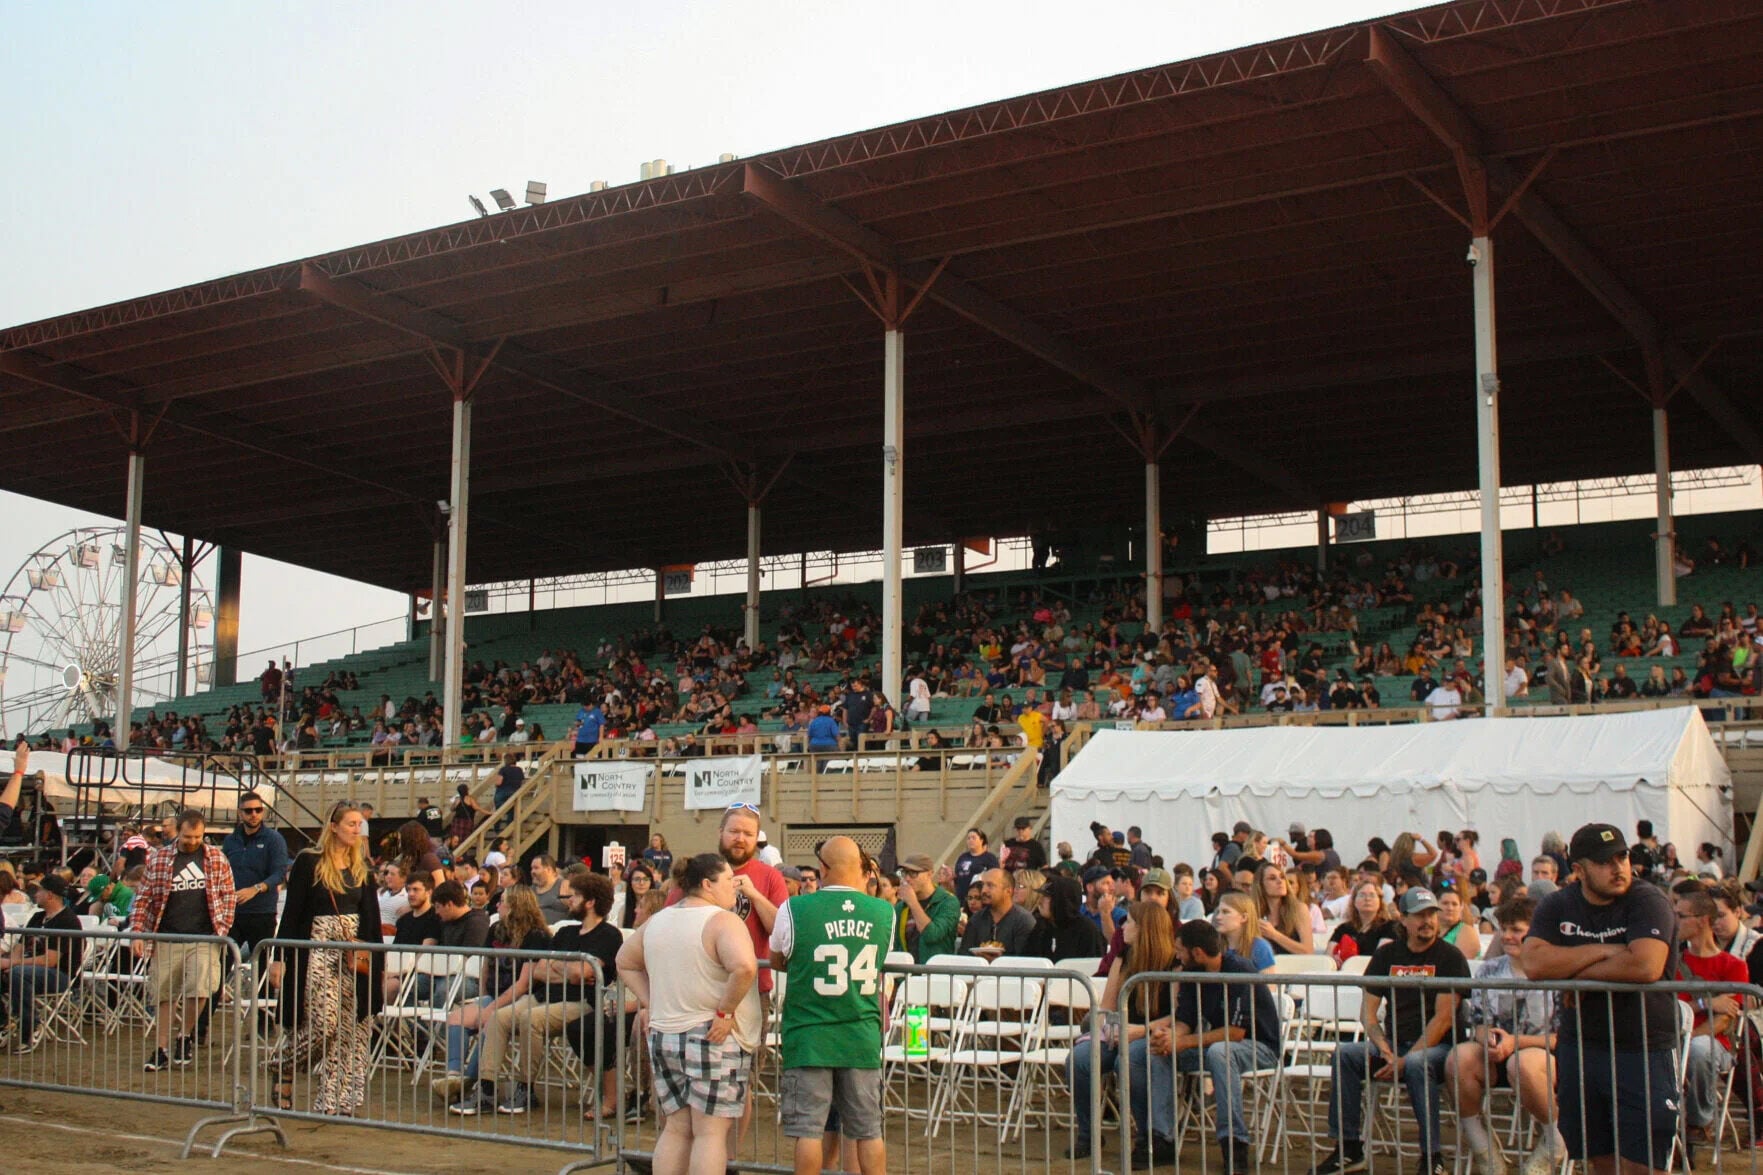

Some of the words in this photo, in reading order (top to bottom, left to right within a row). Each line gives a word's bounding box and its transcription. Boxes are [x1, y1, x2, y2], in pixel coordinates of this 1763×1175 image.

[1338, 516, 1372, 537] 204
[916, 551, 944, 569] 203
[666, 573, 689, 591] 202
[713, 770, 739, 779] NORTH
[171, 879, 206, 892] adida
[824, 919, 873, 940] PIERCE
[1559, 921, 1627, 944] Champion
[813, 943, 878, 996] 34
